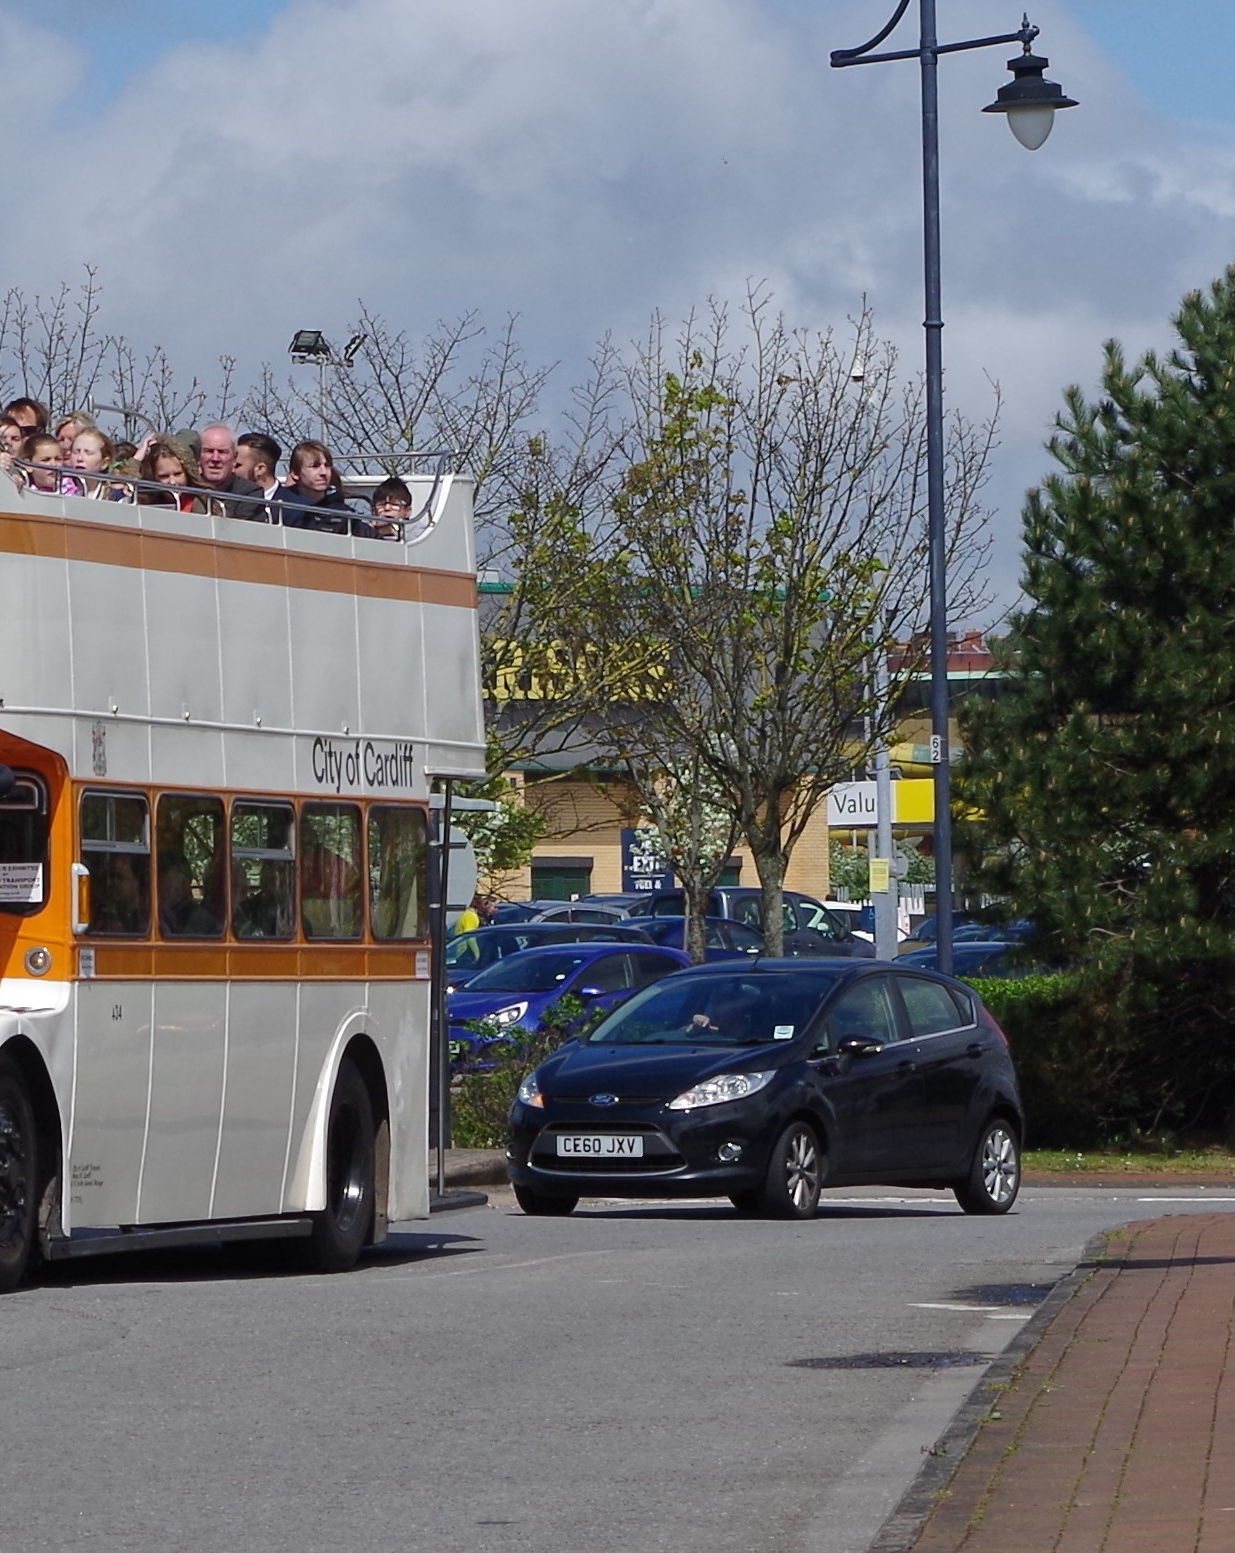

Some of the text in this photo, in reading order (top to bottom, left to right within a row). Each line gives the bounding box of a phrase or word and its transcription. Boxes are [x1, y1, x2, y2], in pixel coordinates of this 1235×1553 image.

[312, 735, 414, 794] City of Cardiff
[563, 1138, 636, 1154] CE60 JXV
